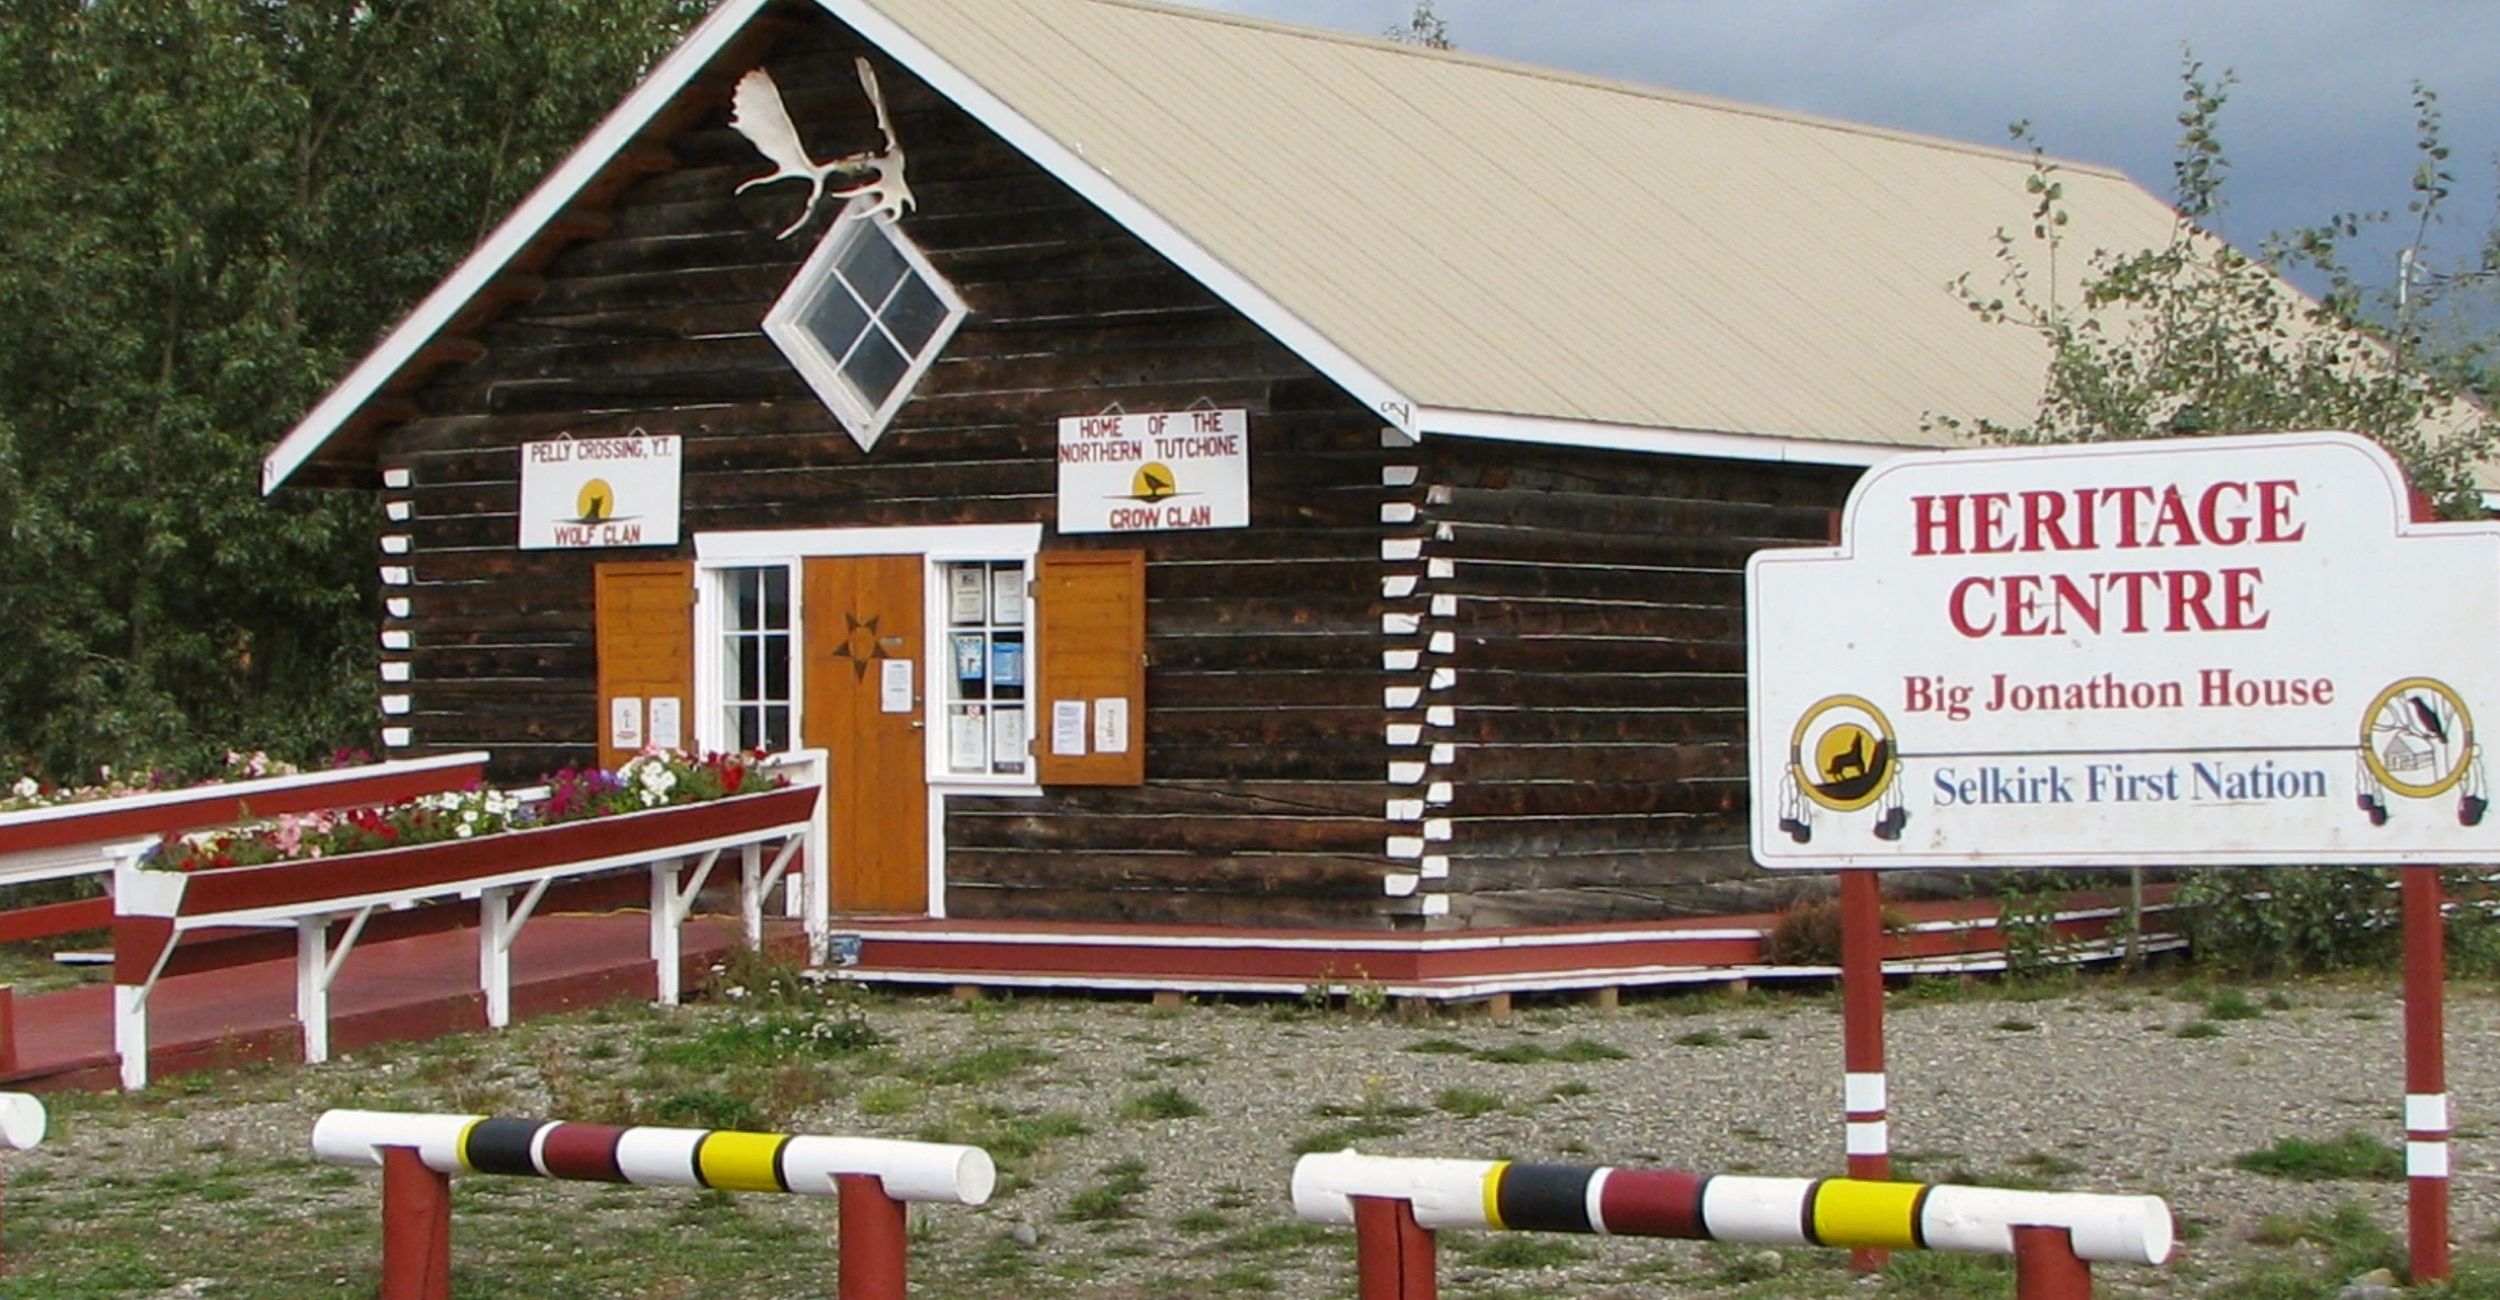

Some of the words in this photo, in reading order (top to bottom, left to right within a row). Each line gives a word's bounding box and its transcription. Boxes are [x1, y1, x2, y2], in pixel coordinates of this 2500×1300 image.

[1080, 416, 1123, 438] HOME
[1148, 415, 1169, 435] OF
[1192, 412, 1223, 433] THE
[531, 442, 572, 463] PELLY
[577, 438, 648, 460] CROSSING,
[1059, 440, 1142, 463] NORTHERN
[1155, 435, 1239, 459] TUTCHONE
[1110, 507, 1160, 529] CROW
[1166, 505, 1211, 526] CLAN
[1910, 479, 2307, 556] HERITAGE
[554, 526, 596, 546] WOLF
[603, 524, 642, 544] CLAN
[1948, 566, 2271, 638] CENTRE
[1903, 674, 1974, 721] Big
[1985, 671, 2184, 712] Jonathon
[2198, 667, 2335, 708] House
[1932, 764, 2076, 807] Selkirk
[2086, 763, 2180, 802] First
[2189, 759, 2327, 801] Nation
